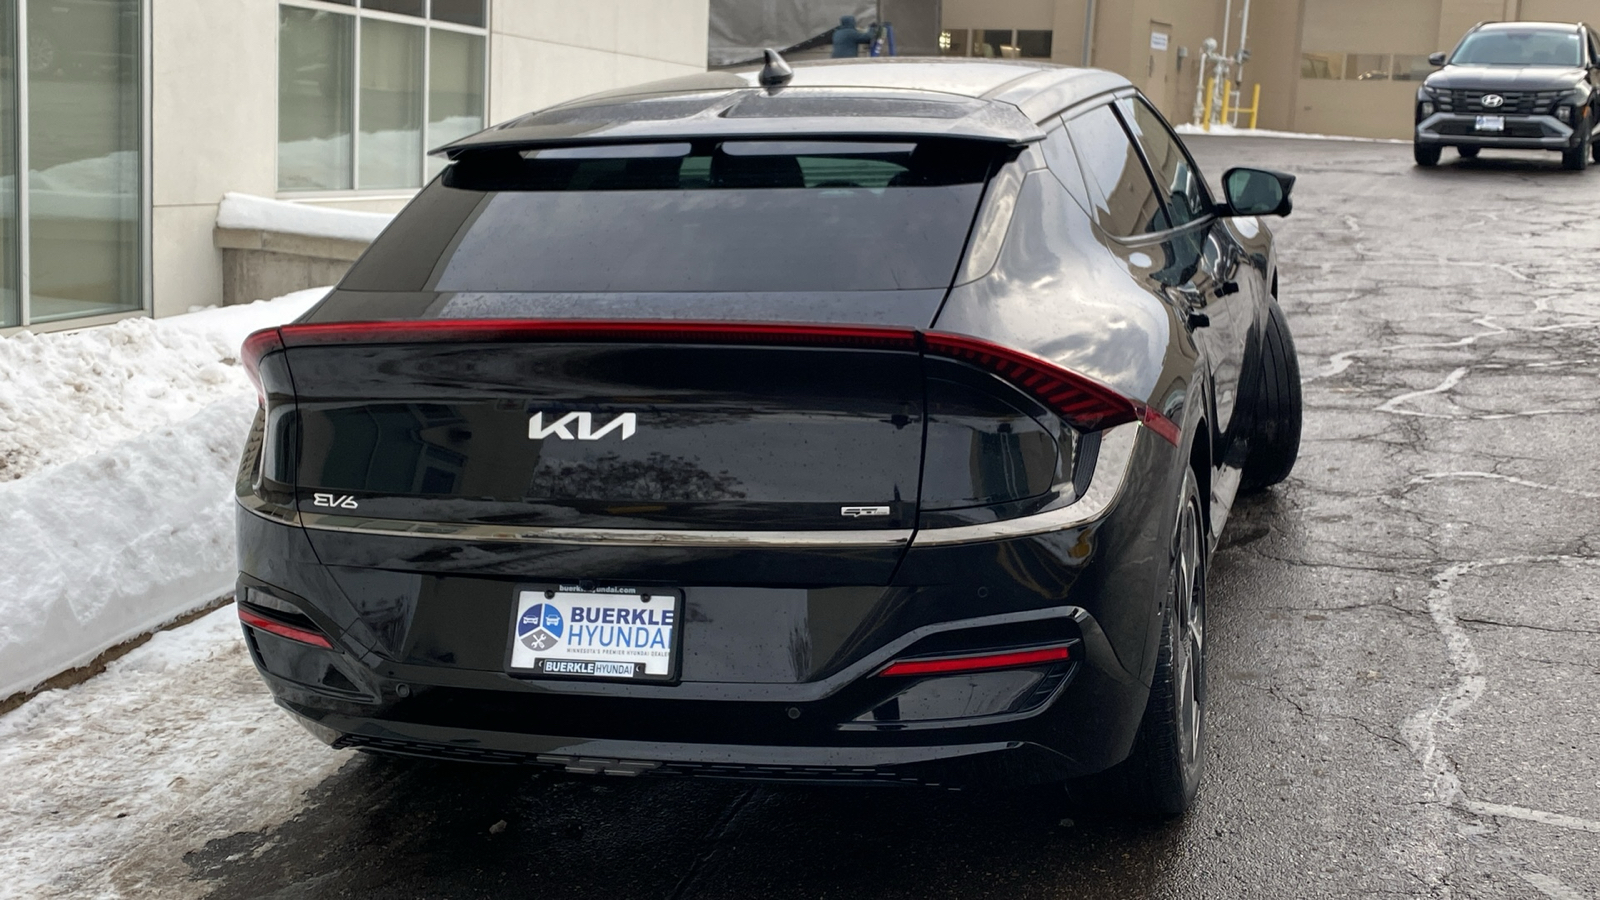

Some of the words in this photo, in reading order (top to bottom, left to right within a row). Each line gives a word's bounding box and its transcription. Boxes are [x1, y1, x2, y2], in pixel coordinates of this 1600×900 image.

[528, 411, 637, 440] KIA
[313, 492, 358, 509] EV6
[571, 606, 674, 626] BUERKLE
[545, 661, 595, 674] BUERKLE
[595, 663, 633, 675] HYUNDAI
